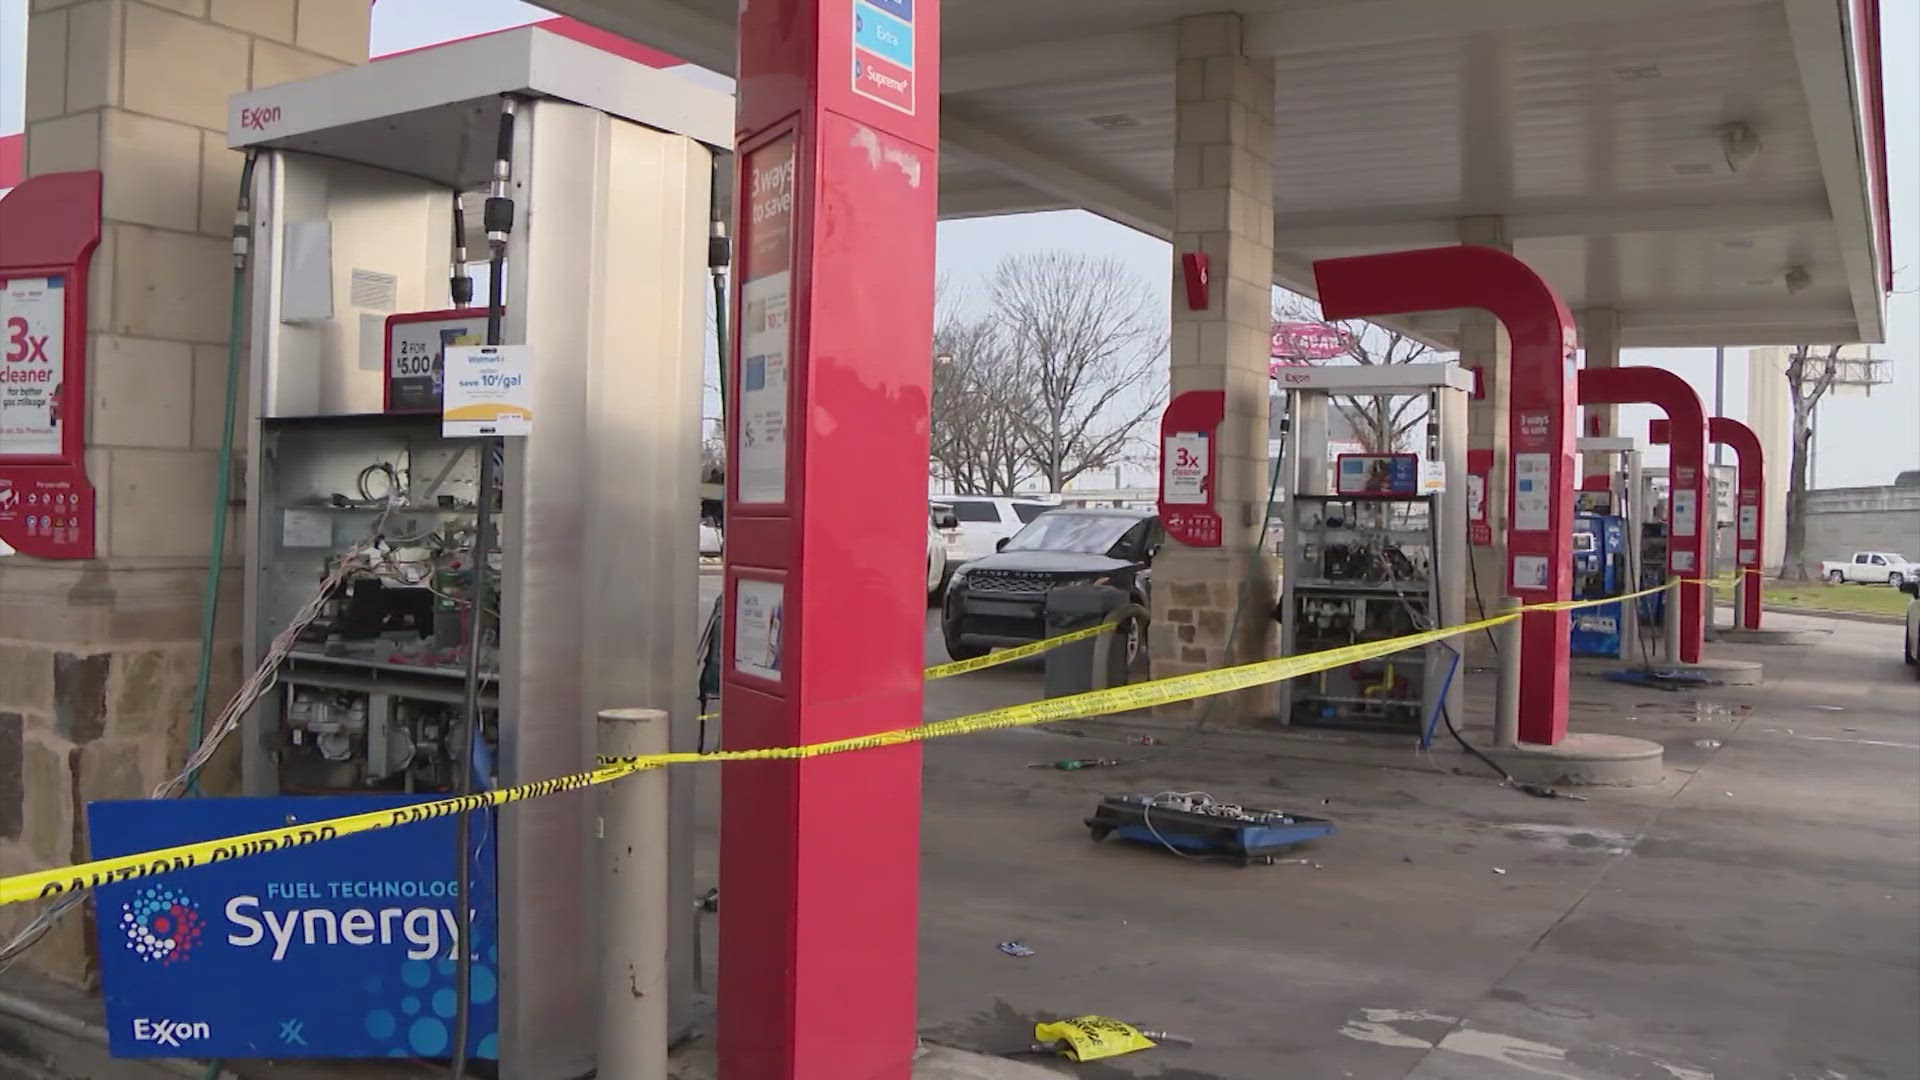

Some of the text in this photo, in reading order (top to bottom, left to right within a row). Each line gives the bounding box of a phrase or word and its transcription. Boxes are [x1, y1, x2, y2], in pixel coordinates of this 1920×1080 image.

[241, 105, 281, 130] Exxon
[751, 168, 760, 197] 3
[752, 193, 790, 224] to save
[1200, 266, 1208, 284] 6
[6, 317, 49, 363] 3x
[401, 341, 426, 354] 2 FOR
[0, 365, 53, 383] cleaner
[1176, 447, 1199, 468] 3x
[267, 880, 475, 899] FUEL TECHNOLOG
[225, 895, 477, 961] Synergy
[133, 1018, 211, 1048] Exxon
